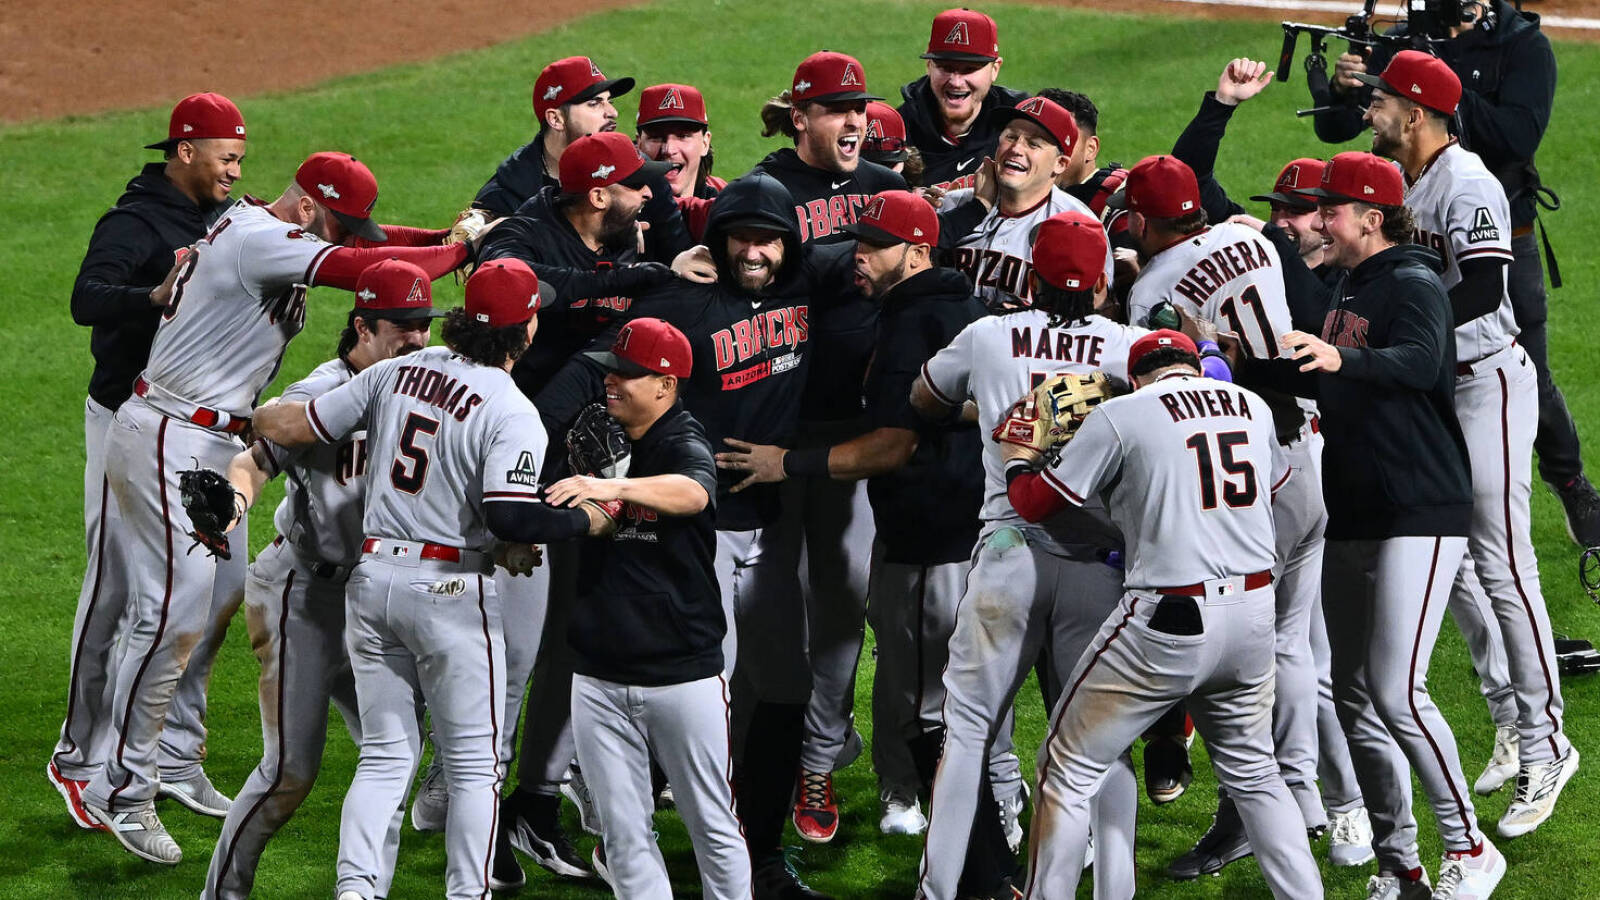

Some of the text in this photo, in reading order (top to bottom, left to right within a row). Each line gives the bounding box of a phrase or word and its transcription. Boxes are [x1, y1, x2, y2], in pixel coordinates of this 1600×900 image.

[1174, 238, 1272, 308] HERRERA
[710, 305, 809, 372] D-BACKS
[1011, 327, 1105, 366] MARTE
[1220, 284, 1280, 360] 11
[393, 365, 483, 422] THOMAS
[1158, 389, 1252, 423] RIVERA
[390, 411, 440, 496] 5
[509, 472, 536, 486] AVNE
[1186, 430, 1258, 511] 15
